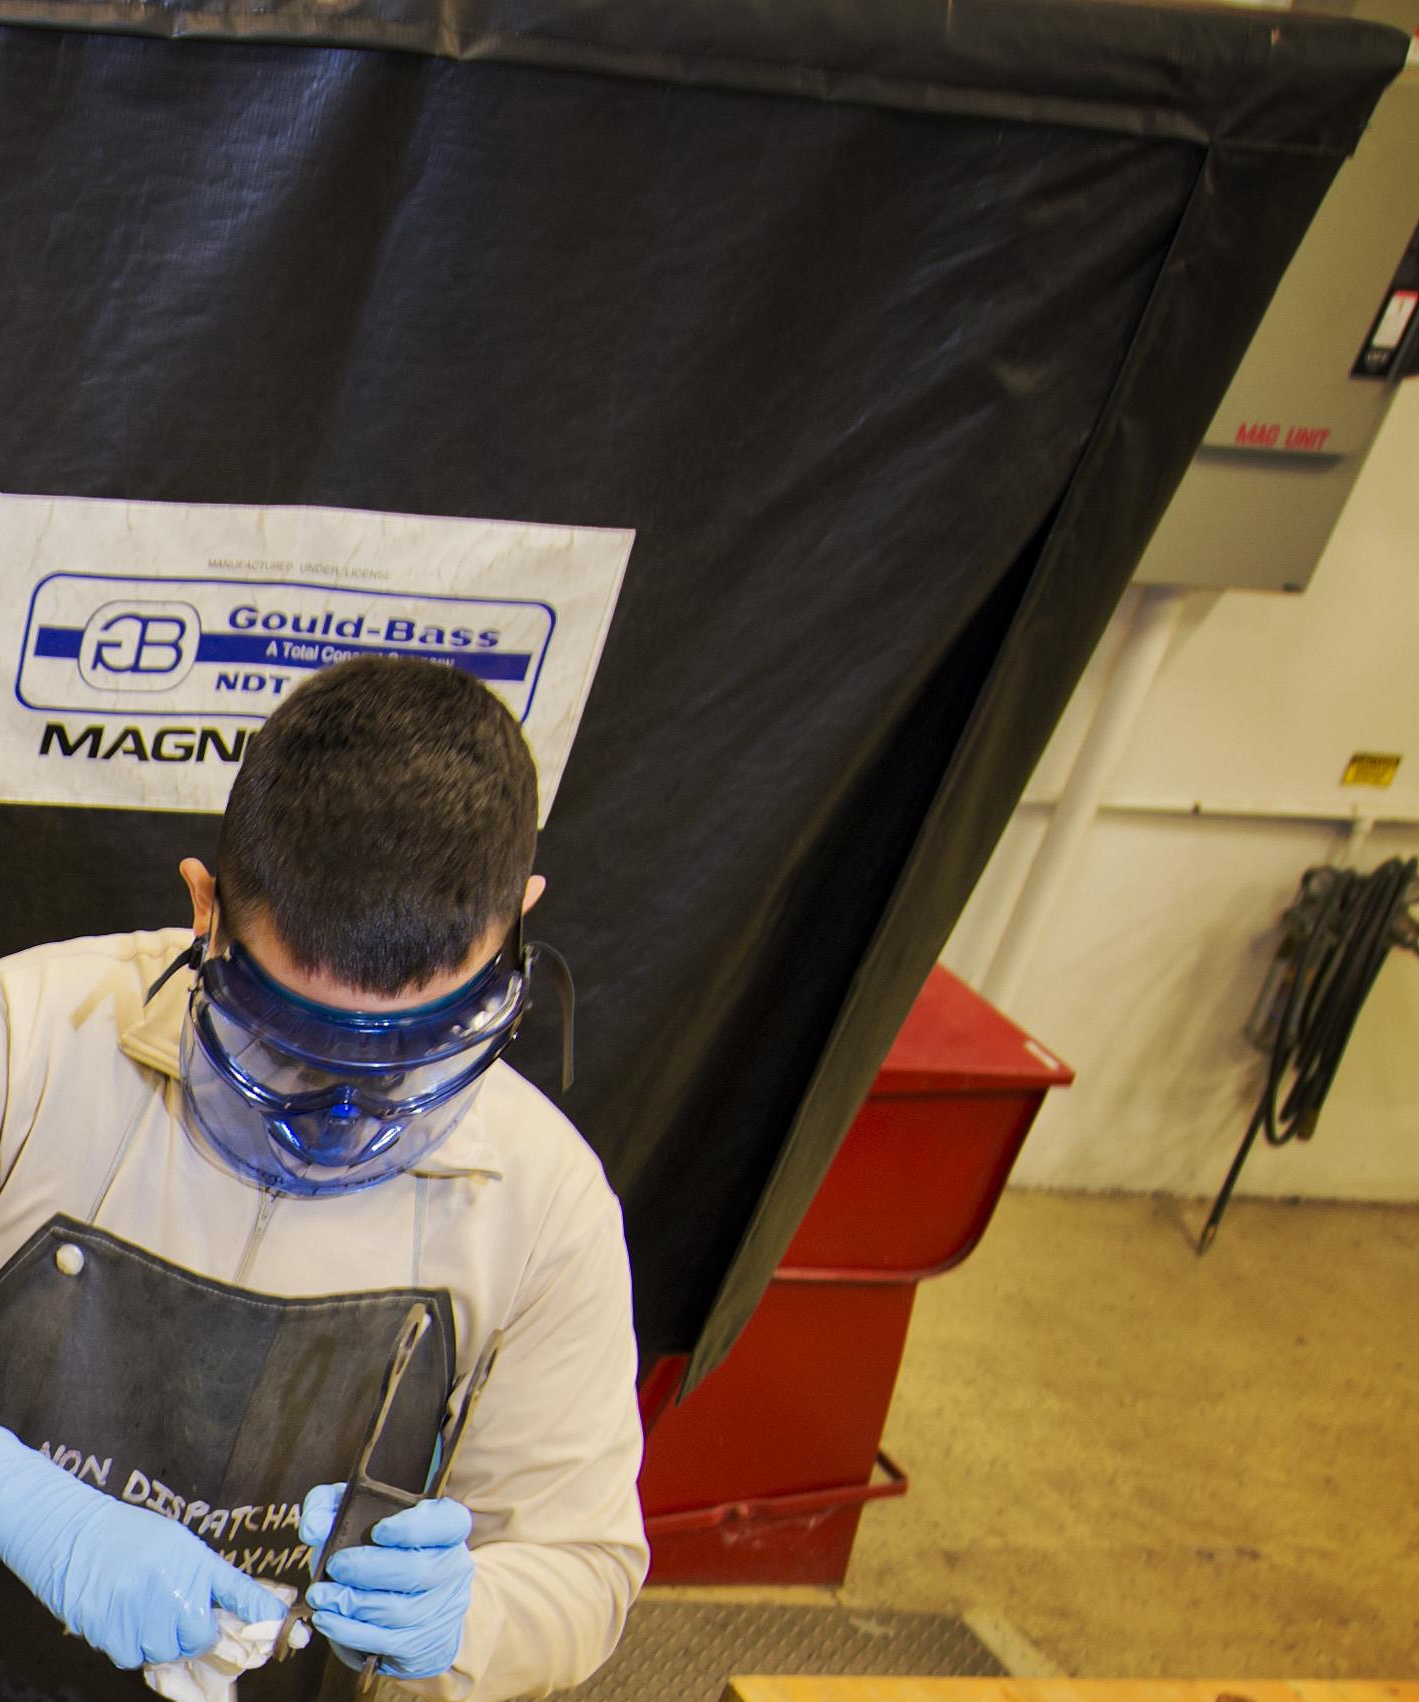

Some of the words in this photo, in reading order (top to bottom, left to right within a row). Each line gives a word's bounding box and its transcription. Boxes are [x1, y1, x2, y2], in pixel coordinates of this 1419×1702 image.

[1284, 424, 1331, 451] UNIT
[207, 558, 293, 572] MANUFACTURED
[299, 562, 340, 576] UNDER
[344, 567, 395, 581] LICENSE
[227, 605, 501, 649] Gould-Bass
[265, 639, 278, 658] A
[282, 641, 319, 662] Total
[215, 671, 291, 694] NDT
[38, 721, 261, 763] MAGN
